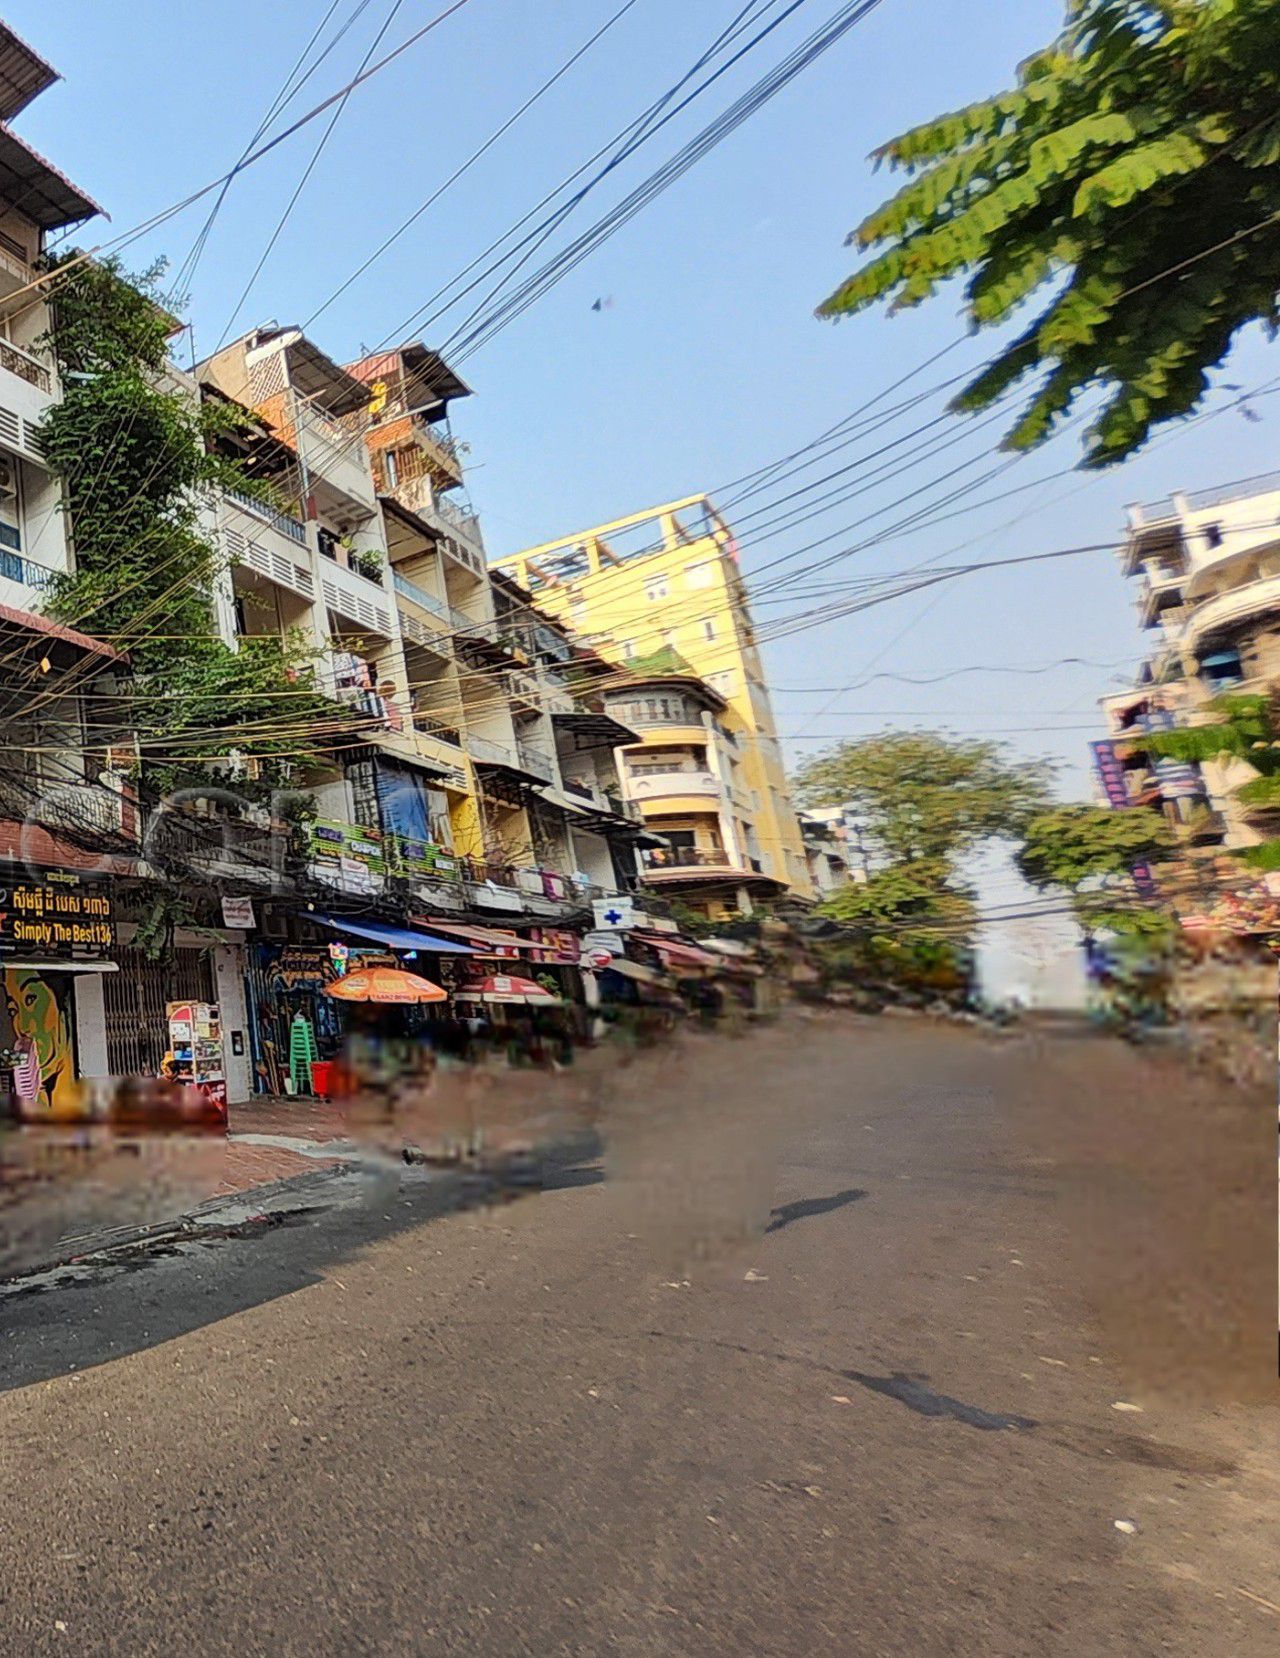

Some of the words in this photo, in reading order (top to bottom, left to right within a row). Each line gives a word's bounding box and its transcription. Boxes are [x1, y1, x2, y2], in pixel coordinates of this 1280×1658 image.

[14, 920, 52, 944] Simply
[53, 923, 71, 941] The
[73, 924, 95, 942] Best
[96, 925, 111, 946] 136
